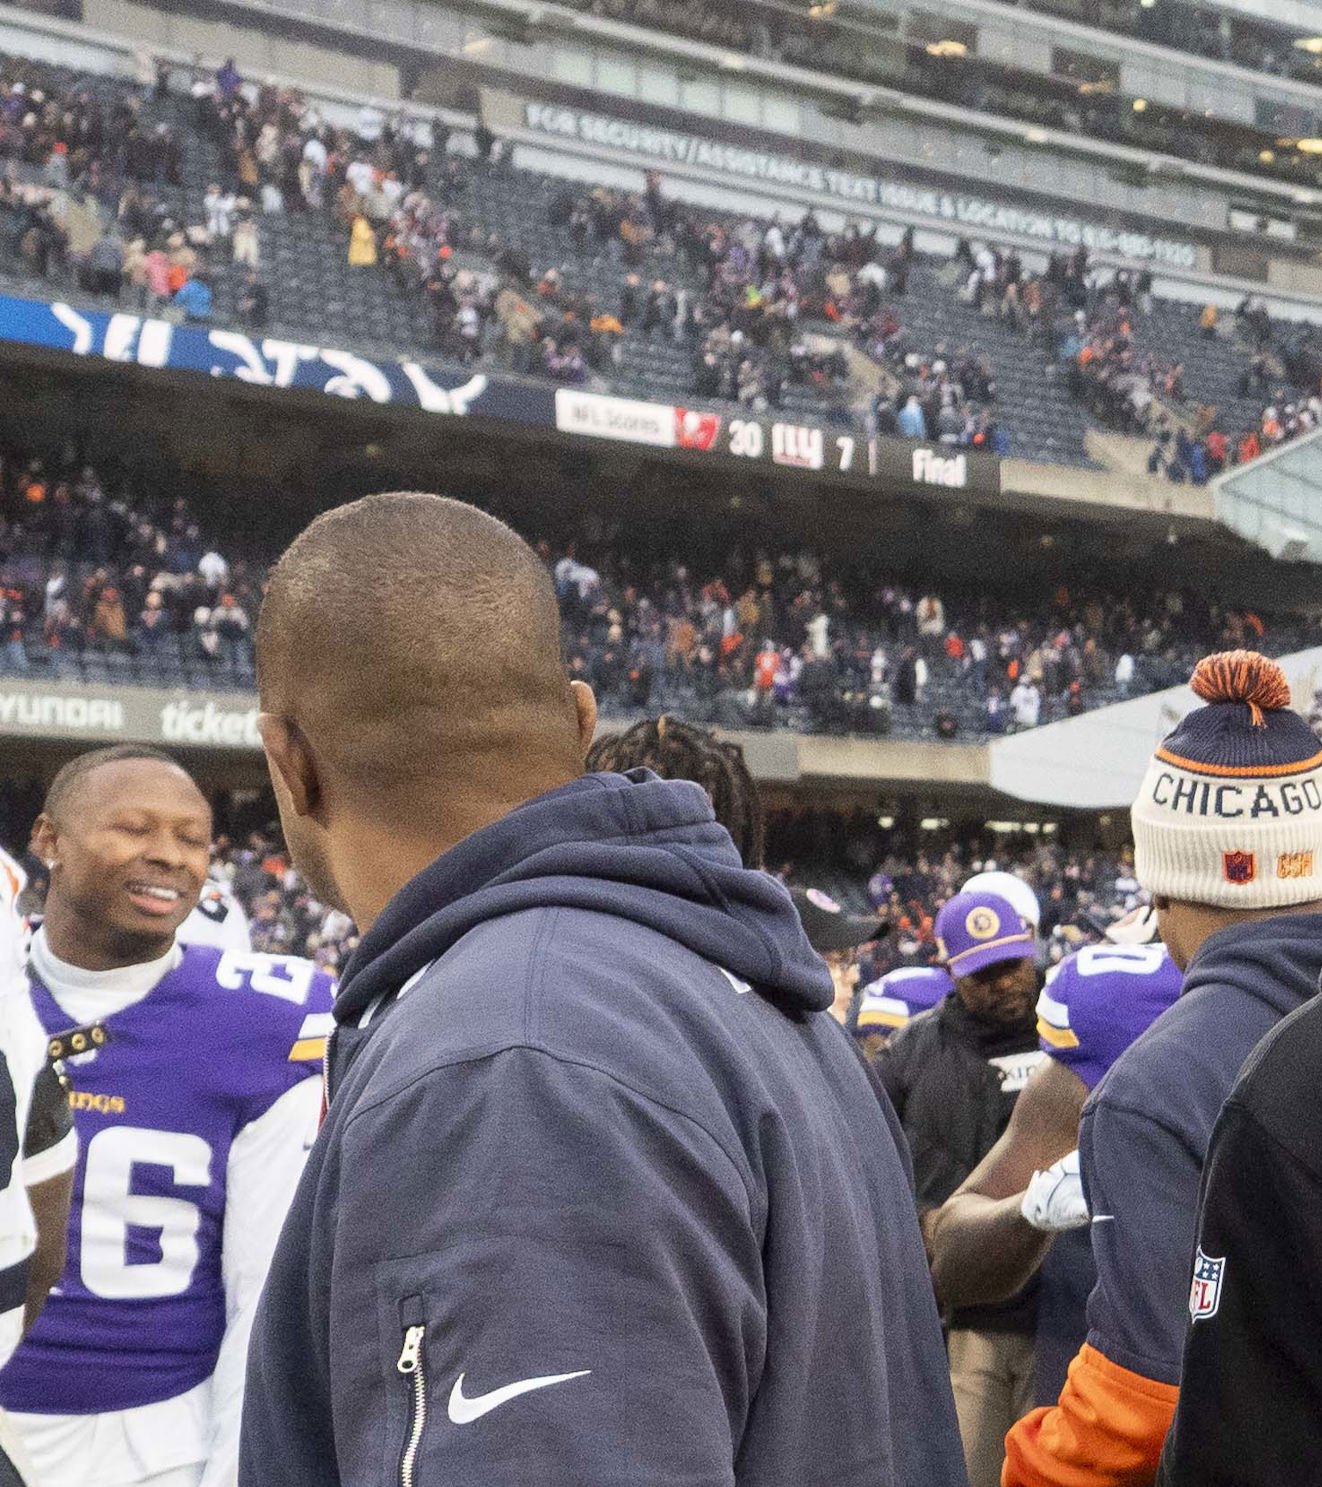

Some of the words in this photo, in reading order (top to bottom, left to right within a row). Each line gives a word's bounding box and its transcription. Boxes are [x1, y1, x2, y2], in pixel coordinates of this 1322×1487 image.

[526, 103, 577, 135] FOR
[828, 171, 877, 200] TEXT
[957, 197, 1054, 236] LOCATION
[729, 419, 762, 458] 30
[836, 436, 854, 471] 7
[912, 447, 967, 488] Final
[0, 694, 124, 731] YUNDAI
[160, 698, 262, 748] ticket
[1153, 772, 1322, 819] CHICAGO
[81, 1125, 213, 1299] 6
